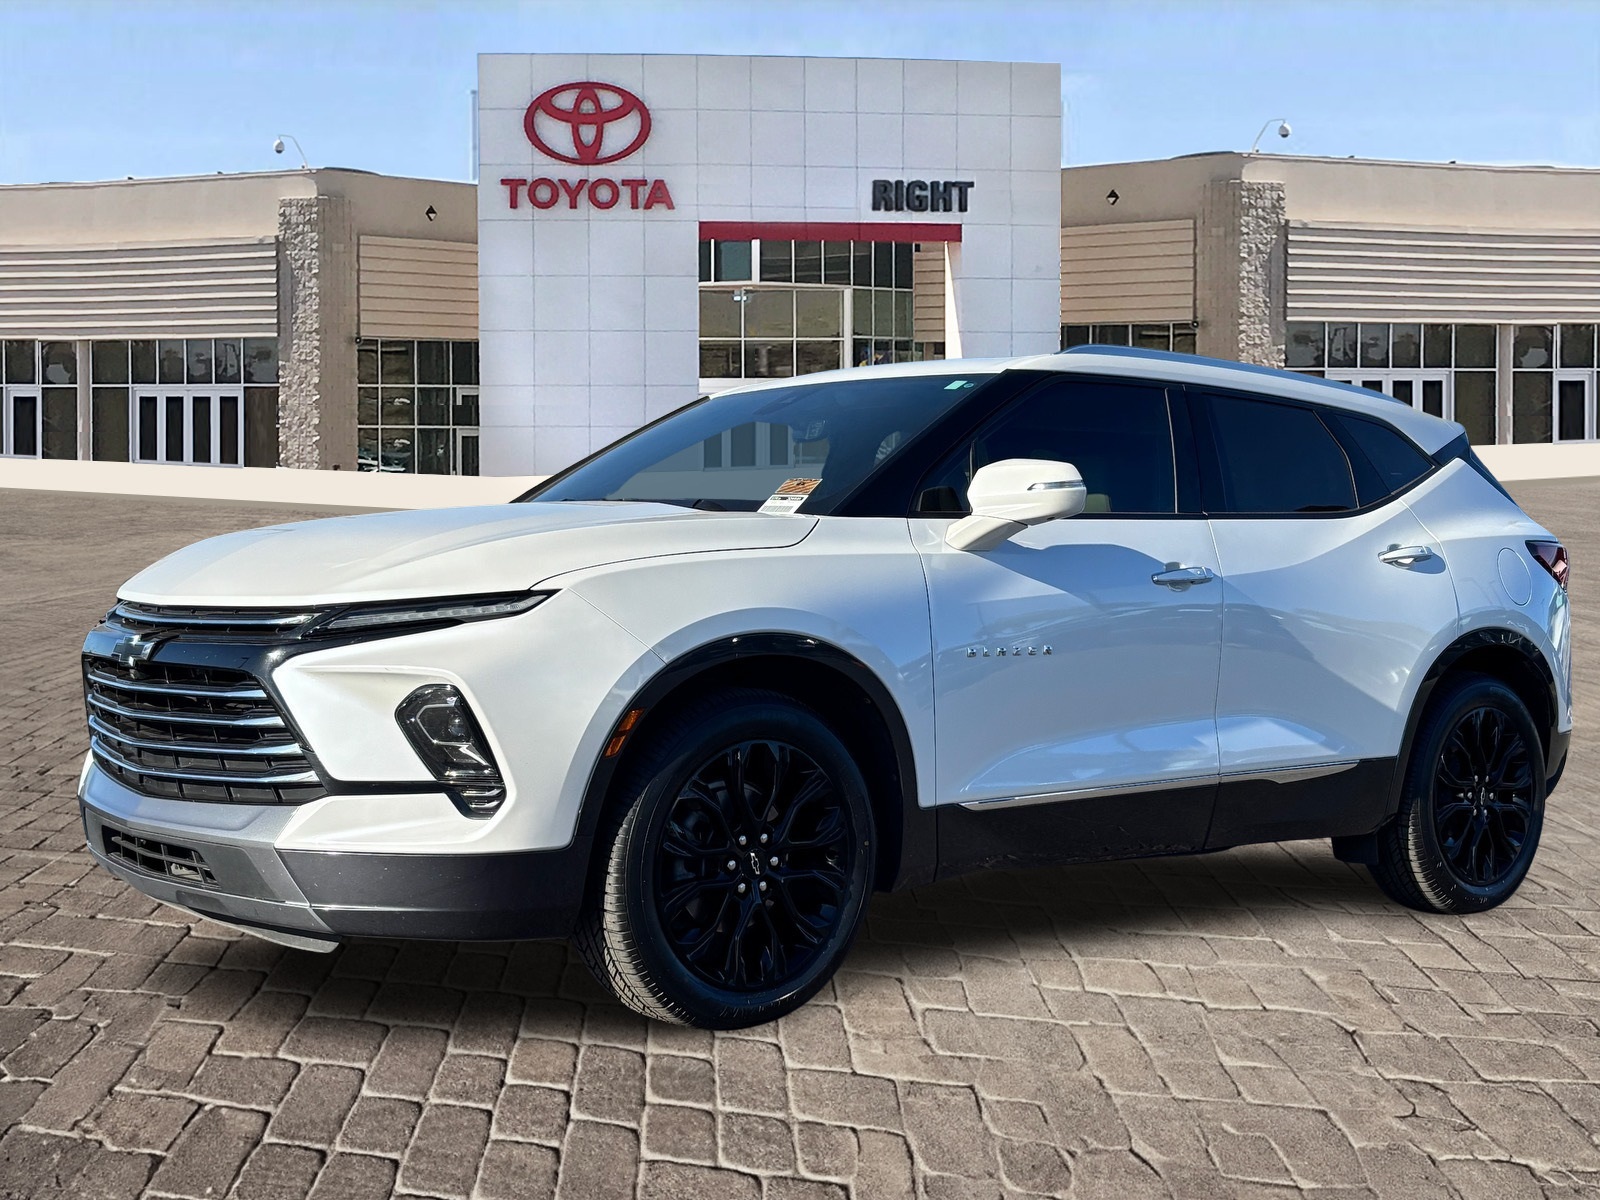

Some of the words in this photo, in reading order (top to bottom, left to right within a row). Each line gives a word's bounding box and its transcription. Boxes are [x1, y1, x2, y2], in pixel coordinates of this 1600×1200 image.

[500, 178, 675, 210] TOYOTA
[871, 179, 975, 213] RIGHT
[966, 645, 1053, 658] BLAZER
